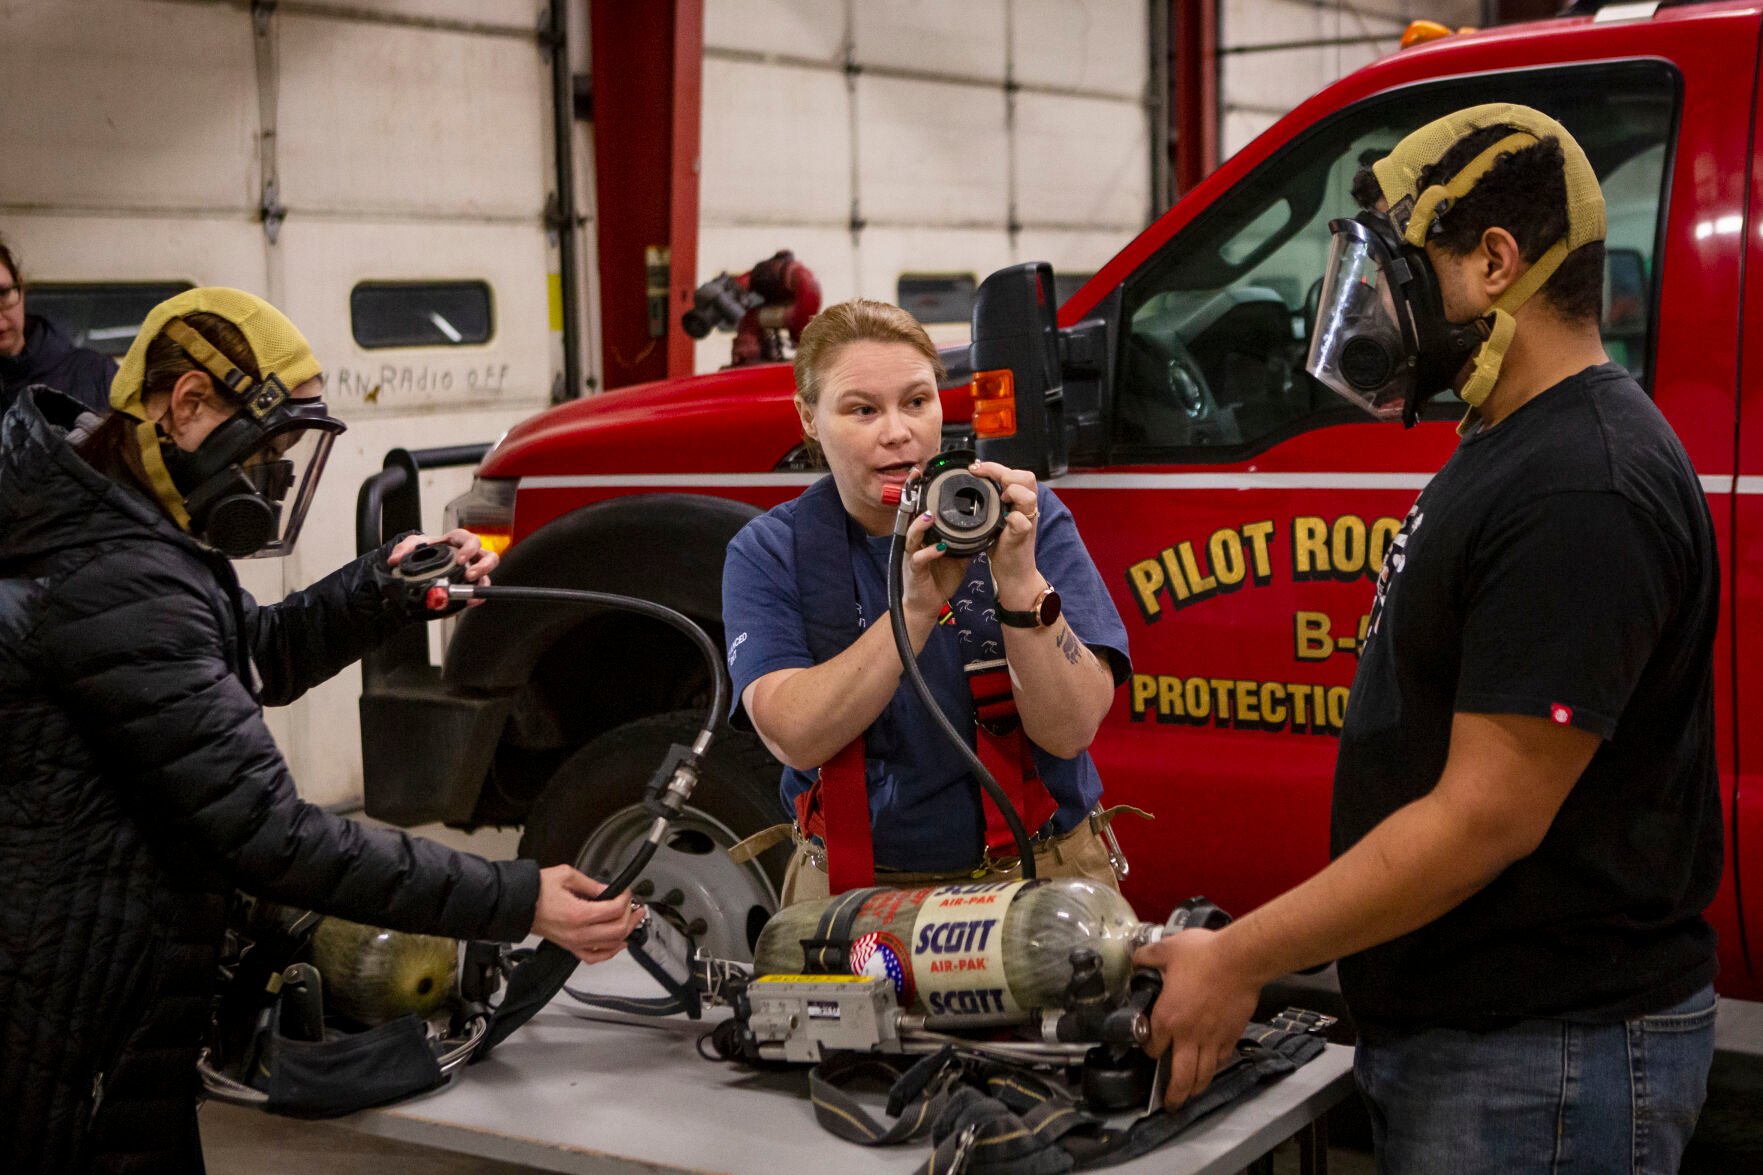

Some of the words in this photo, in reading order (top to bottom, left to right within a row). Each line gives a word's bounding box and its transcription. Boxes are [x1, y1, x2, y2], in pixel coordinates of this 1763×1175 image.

[1127, 519, 1274, 623] PILOT
[1292, 514, 1403, 581] ROC
[1294, 610, 1370, 661] B-
[1131, 673, 1350, 734] PROTECTIO
[939, 895, 997, 907] AIR-PAK
[915, 919, 997, 954] SCOTT
[930, 958, 986, 973] AIR-PAK
[929, 988, 1005, 1015] SCOTT
